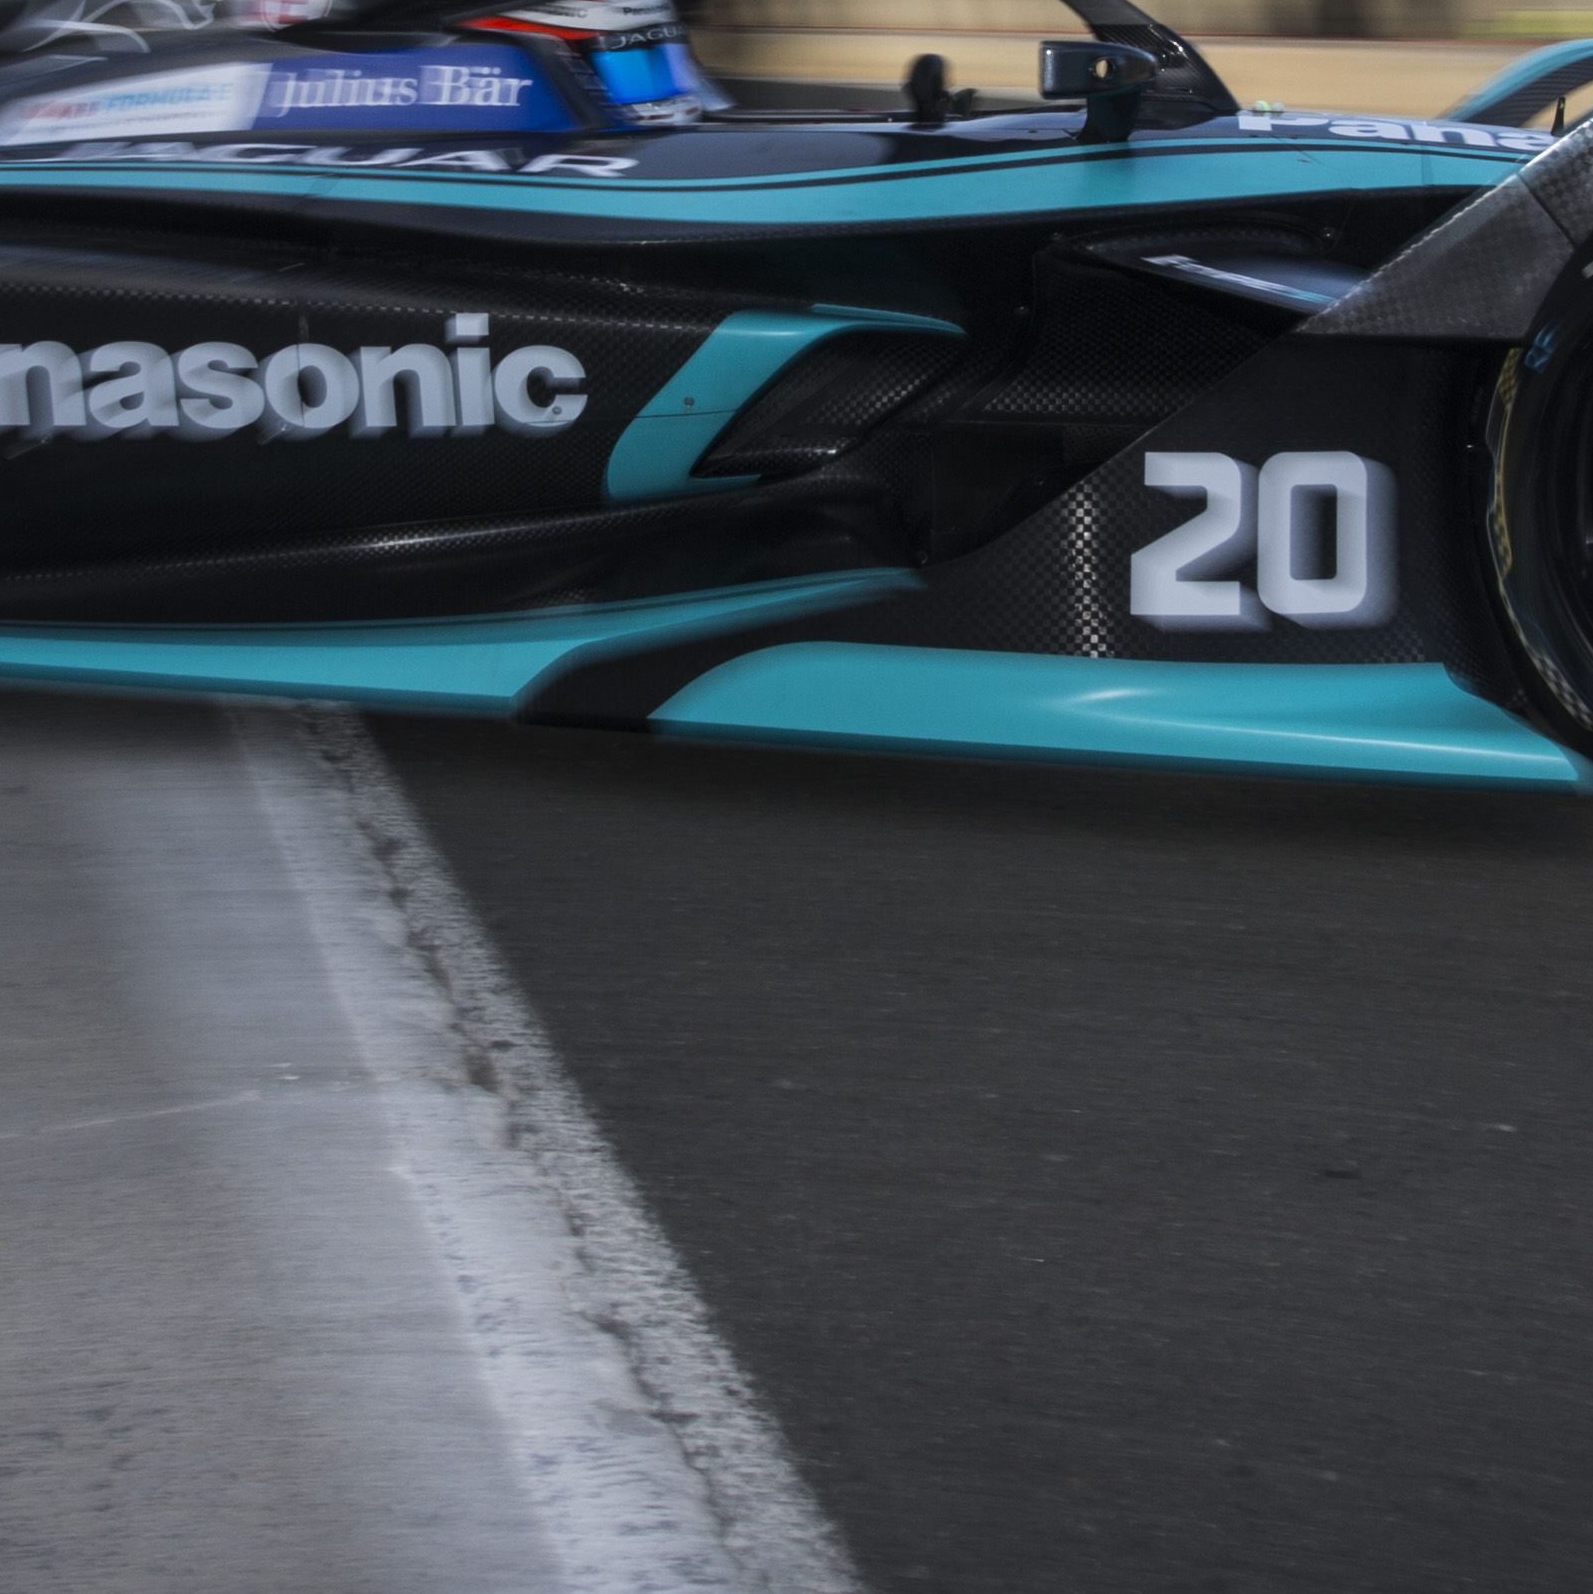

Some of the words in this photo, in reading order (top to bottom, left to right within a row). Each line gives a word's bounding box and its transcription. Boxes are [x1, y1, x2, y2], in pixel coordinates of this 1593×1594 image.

[610, 25, 685, 51] JAGU
[274, 68, 419, 118] Julius
[436, 65, 533, 106] Bär
[1131, 450, 1378, 620] 20
